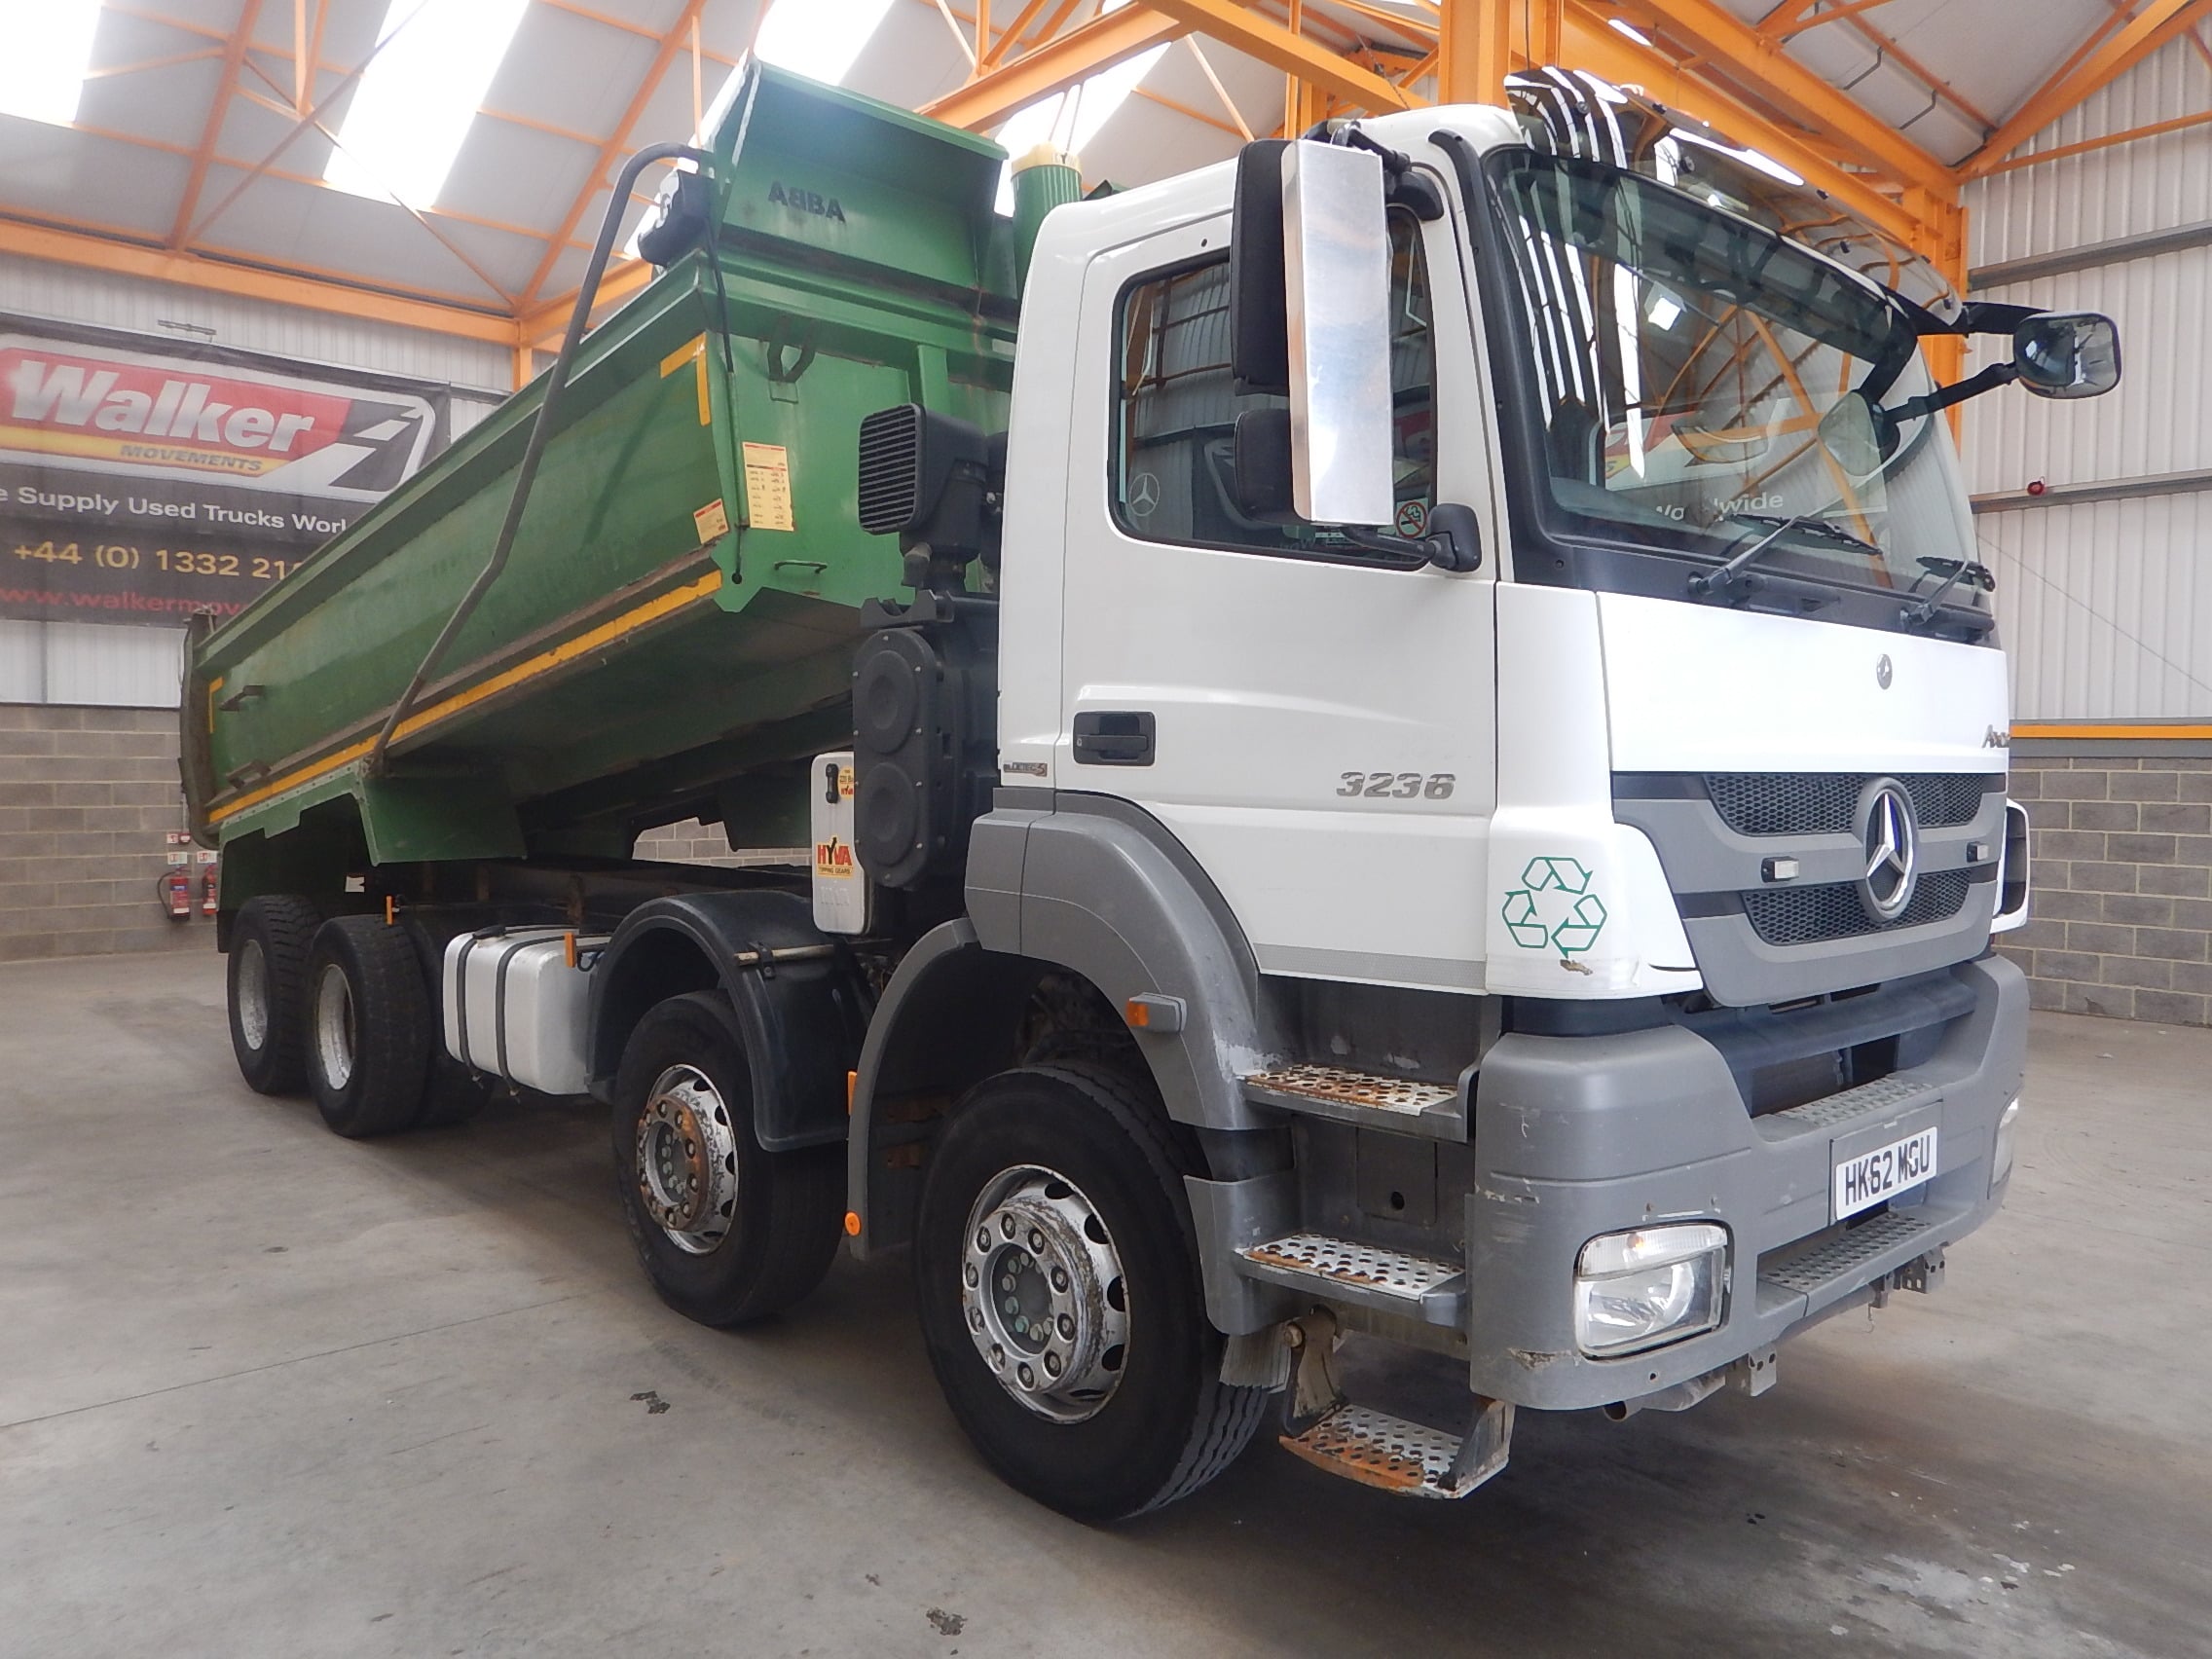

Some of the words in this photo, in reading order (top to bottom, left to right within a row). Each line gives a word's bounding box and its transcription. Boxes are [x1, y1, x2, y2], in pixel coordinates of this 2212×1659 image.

[767, 180, 847, 224] ABBA
[11, 359, 315, 453] Walker
[119, 444, 264, 472] MOVEMENTS
[18, 486, 120, 514] Supply
[128, 498, 196, 520] Used
[203, 504, 285, 529] Trucks
[14, 540, 84, 565] +44
[95, 543, 140, 570] (0)
[155, 549, 240, 577] 1332
[251, 557, 304, 581] 21
[1336, 771, 1456, 800] 3236
[817, 836, 853, 866] HYVA
[1845, 1150, 1893, 1206] HK62
[1898, 1134, 1931, 1184] MGU
